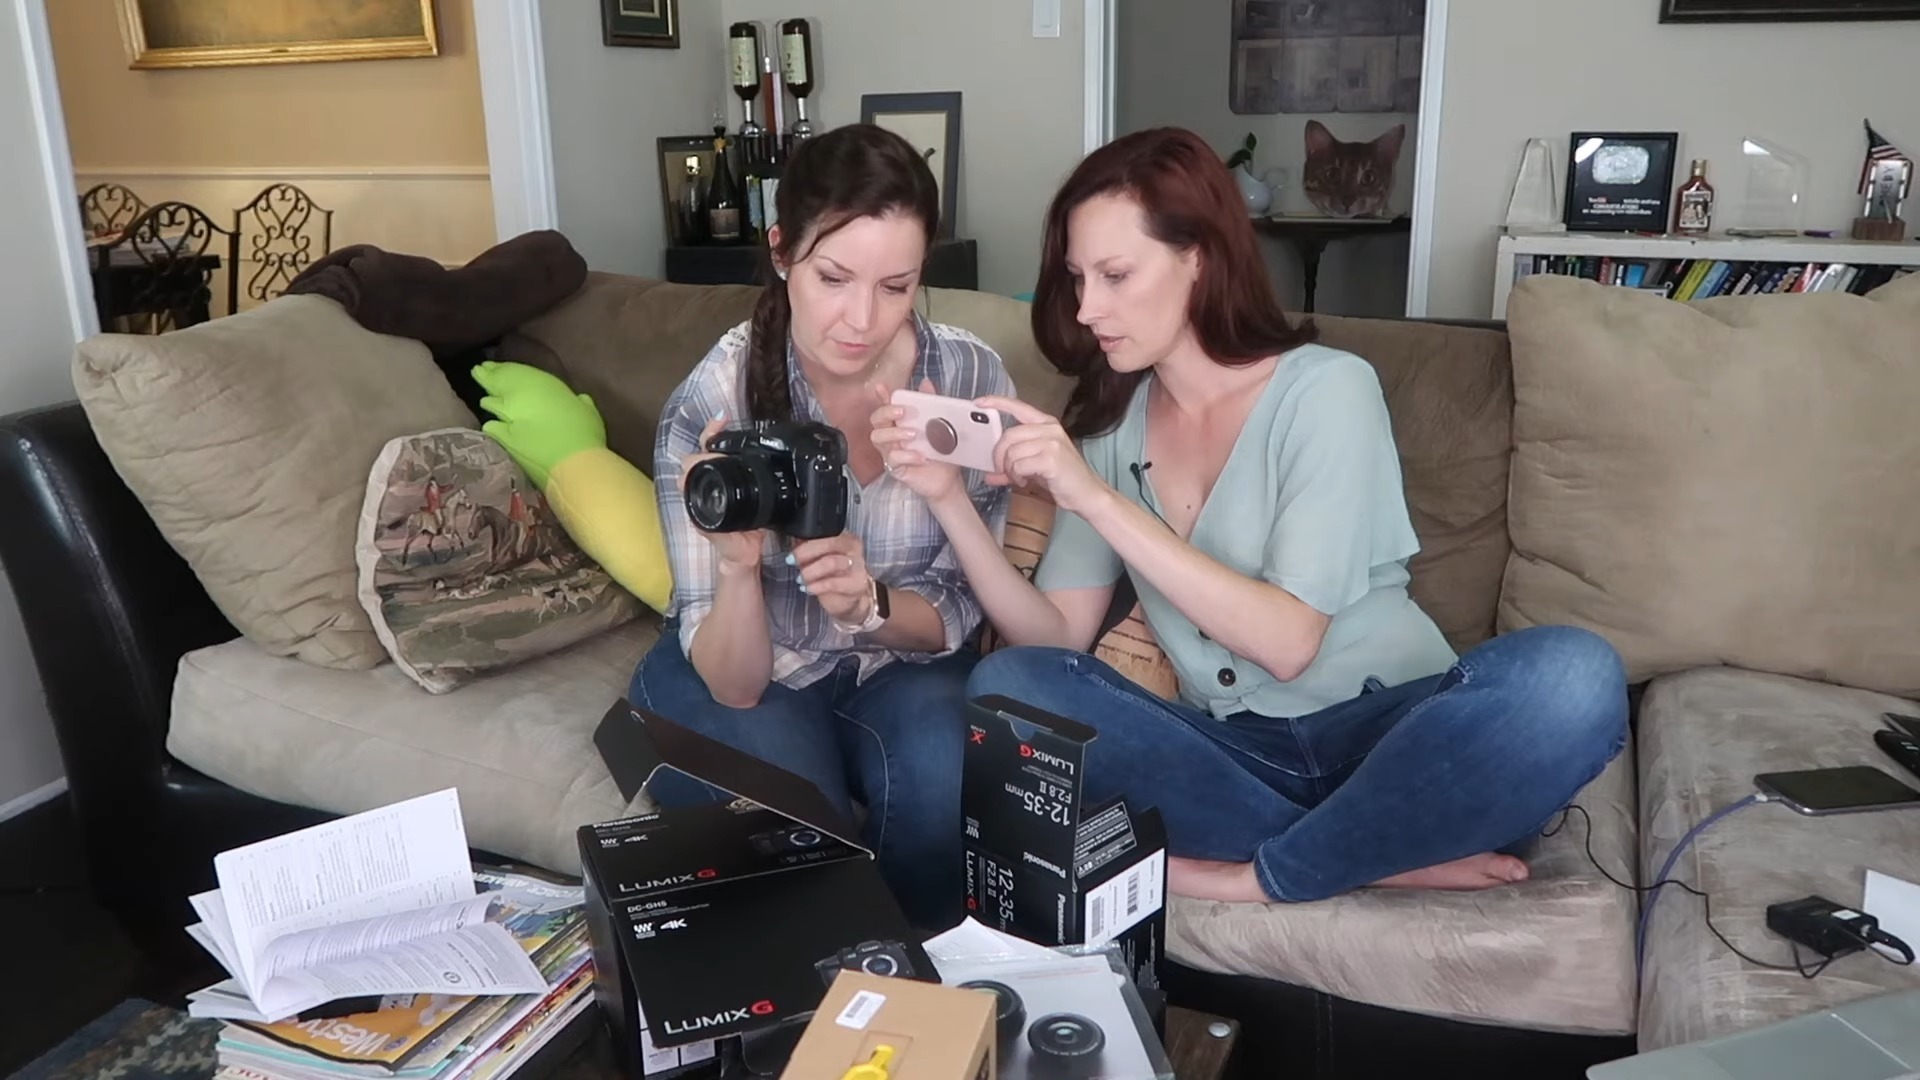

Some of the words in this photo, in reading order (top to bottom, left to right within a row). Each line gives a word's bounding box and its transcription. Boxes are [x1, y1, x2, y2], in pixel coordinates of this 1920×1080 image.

[1032, 748, 1075, 776] LUMIX
[1049, 787, 1072, 805] F2.8
[966, 850, 976, 897] LUMIX
[987, 859, 997, 886] F2.8
[1023, 851, 1067, 879] Panasonic
[618, 872, 695, 894] LUMIX
[999, 868, 1014, 933] 12-35m
[1057, 892, 1066, 946] Panasonic
[663, 1006, 751, 1036] LUMIX
